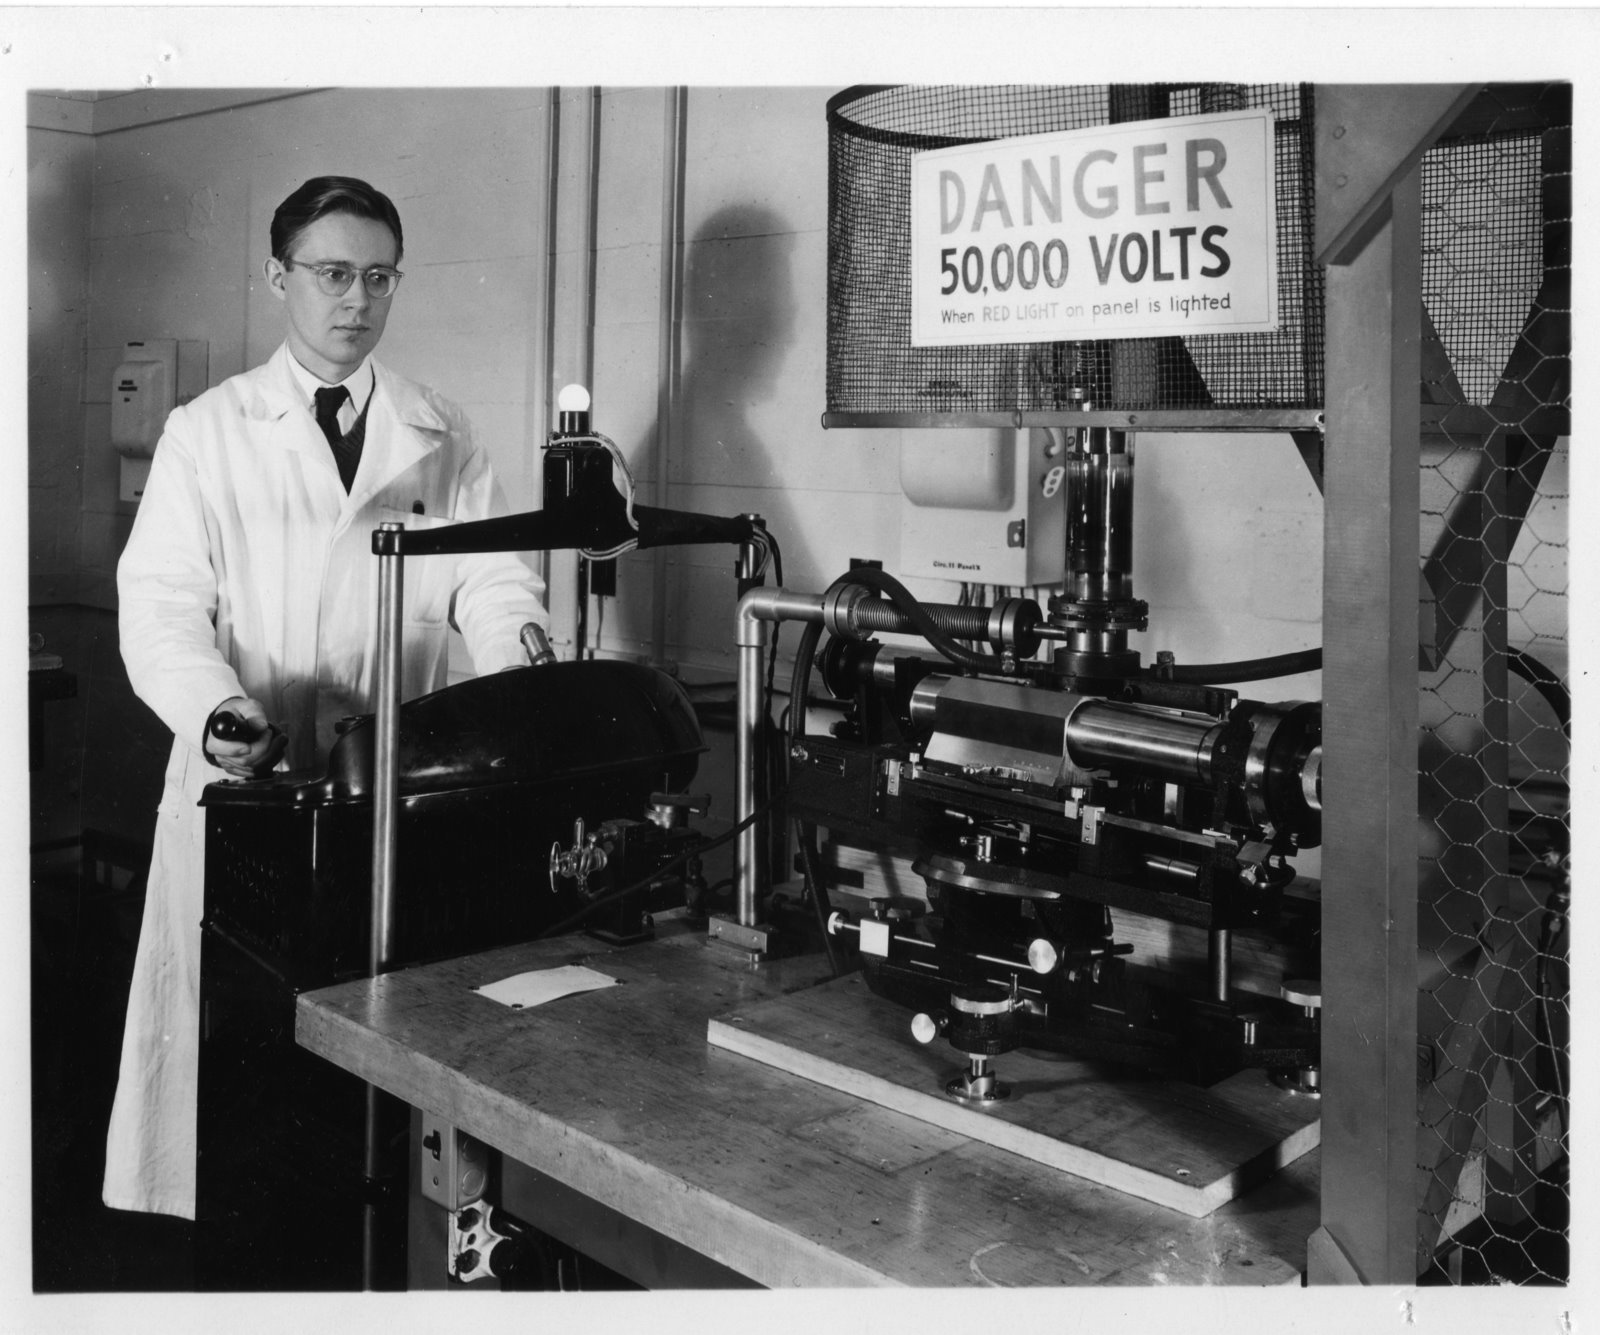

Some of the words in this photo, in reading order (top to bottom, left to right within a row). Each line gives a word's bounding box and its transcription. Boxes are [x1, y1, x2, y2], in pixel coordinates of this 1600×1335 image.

[939, 138, 1233, 235] DANGER
[941, 238, 1069, 296] 50,000
[1089, 225, 1231, 286] VOLTS
[941, 309, 975, 324] When
[983, 306, 1010, 322] RED
[1016, 303, 1059, 320] LIGHT
[1066, 305, 1084, 318] on
[1092, 299, 1138, 323] panel
[1149, 297, 1161, 313] is
[1170, 293, 1231, 318] lighted
